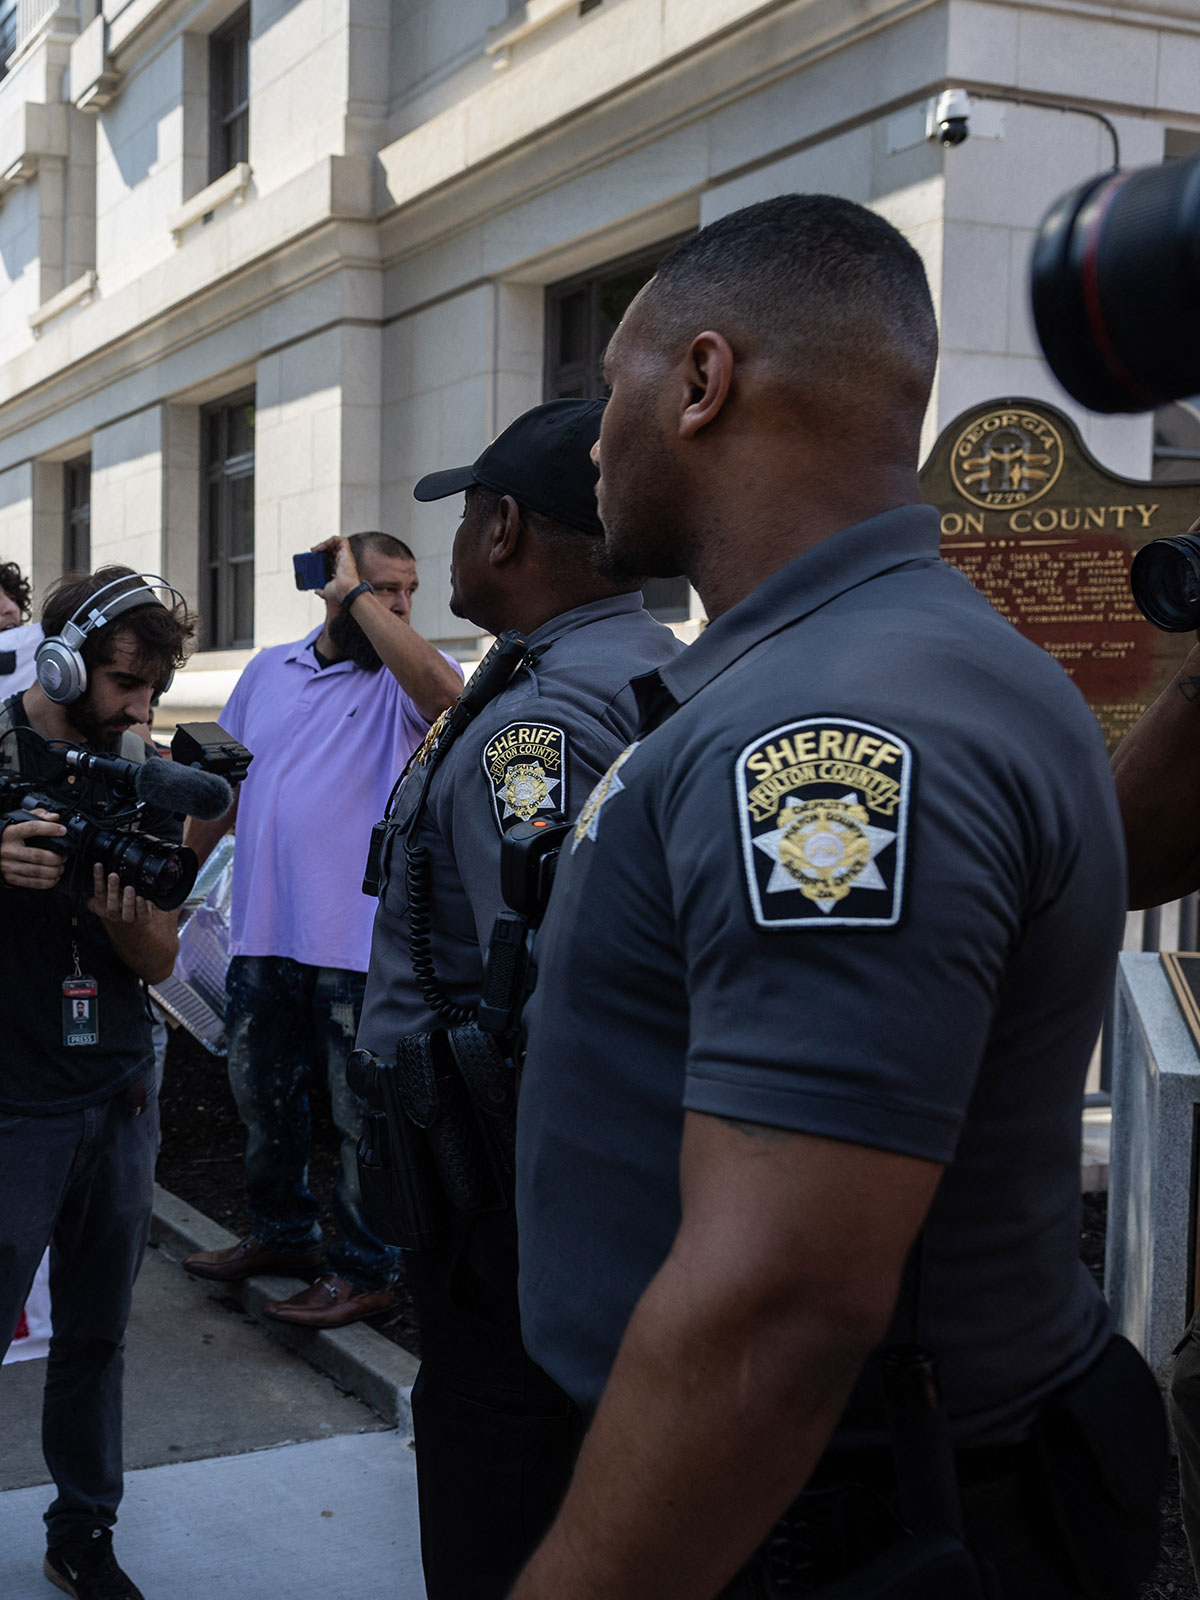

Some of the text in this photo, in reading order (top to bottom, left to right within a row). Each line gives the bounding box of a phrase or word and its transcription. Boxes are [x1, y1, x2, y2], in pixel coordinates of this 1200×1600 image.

[958, 414, 1056, 458] GEORGIA
[1009, 503, 1160, 532] COUNTY
[487, 727, 561, 762] SHERIFF
[492, 744, 556, 772] FULTON COUNTY
[746, 729, 903, 782] SHERIFF
[754, 763, 893, 801] FULTON COUNTY
[71, 1035, 93, 1043] PRESS
